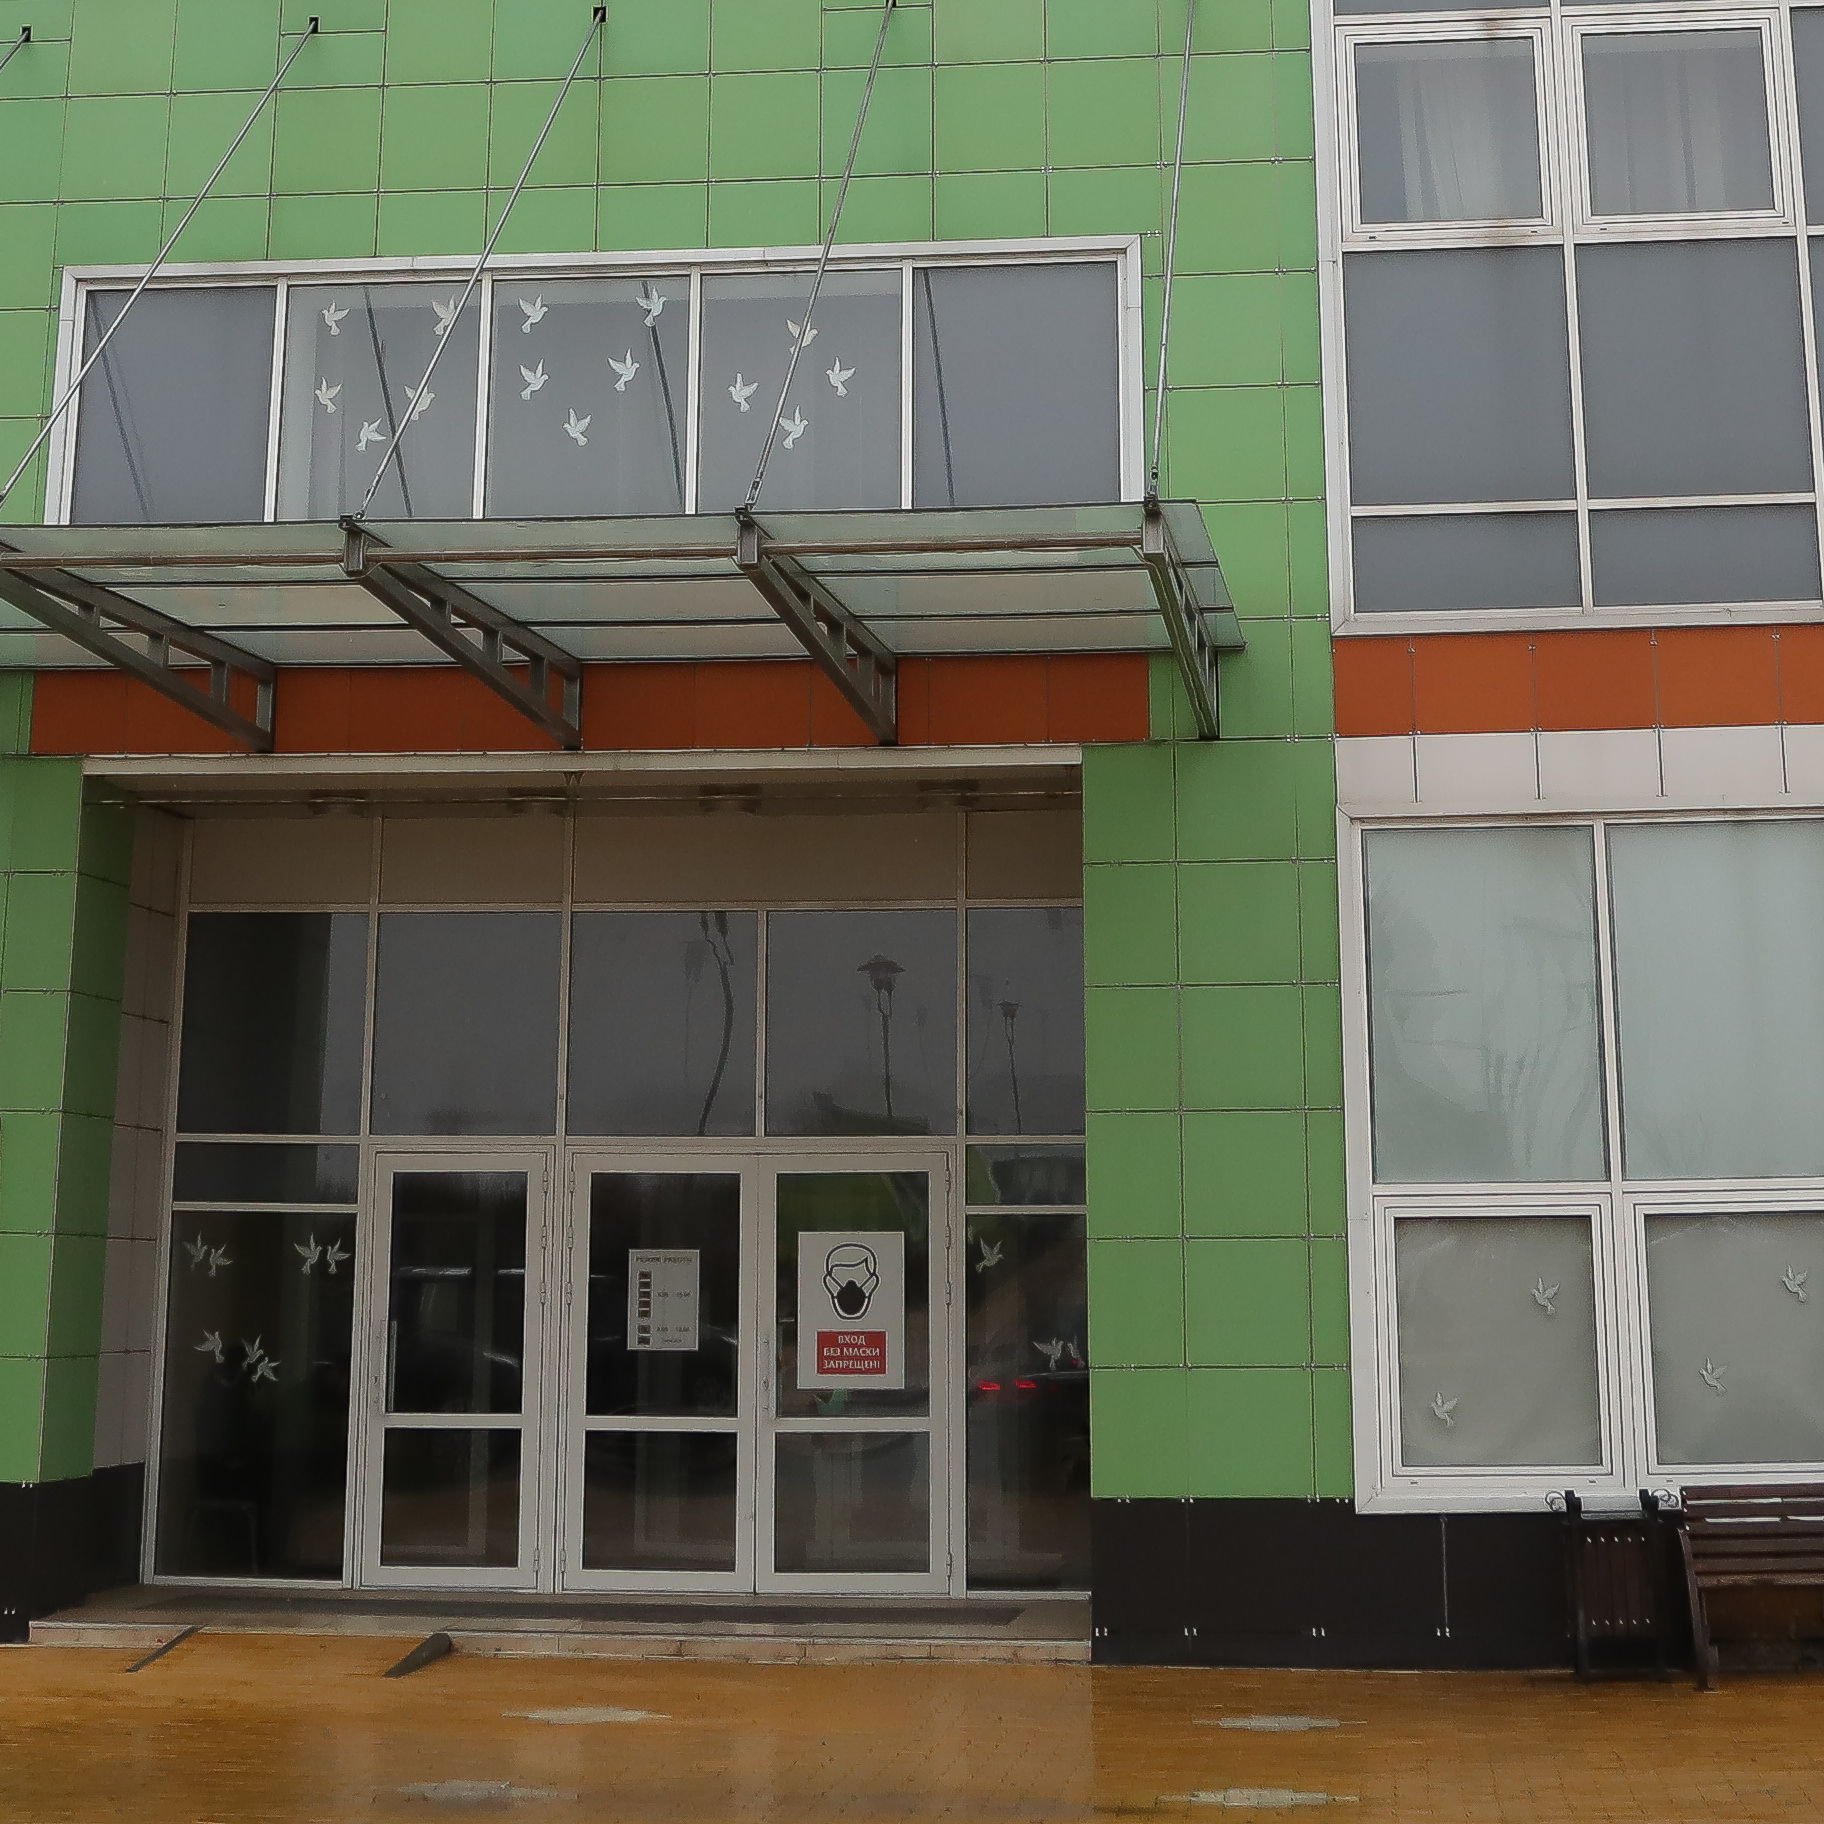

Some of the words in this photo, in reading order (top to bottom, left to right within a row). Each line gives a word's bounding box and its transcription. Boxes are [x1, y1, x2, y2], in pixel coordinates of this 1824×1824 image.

[837, 1335, 866, 1345] ВХОД
[823, 1347, 840, 1356] БЕЗ
[843, 1347, 880, 1356] МАСКИ
